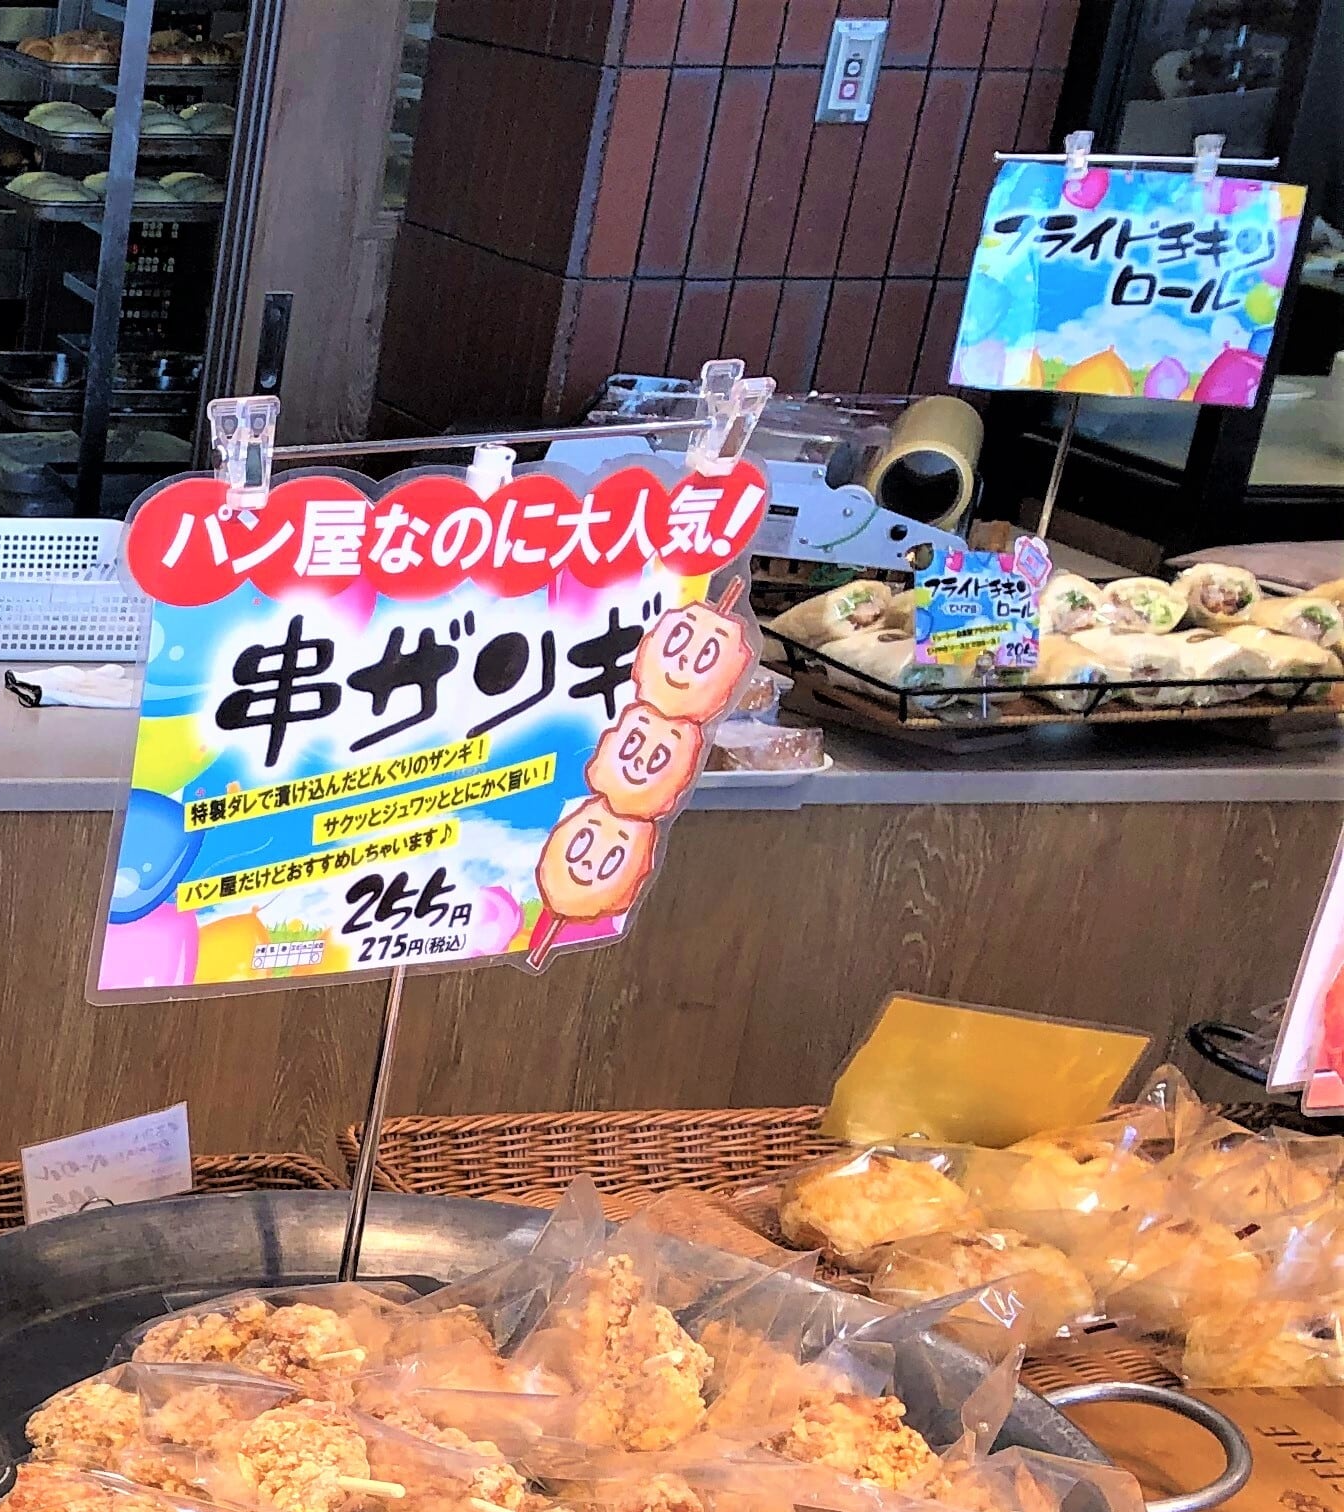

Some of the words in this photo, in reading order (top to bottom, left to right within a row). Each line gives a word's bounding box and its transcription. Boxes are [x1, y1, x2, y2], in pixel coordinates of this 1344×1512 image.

[993, 212, 1276, 267] フライドチキン
[1110, 265, 1242, 315] ロール
[924, 577, 1032, 601] フライドチキン
[997, 600, 1035, 619] ロール
[214, 592, 664, 767] 串ザンギ
[340, 866, 473, 935] 255円
[357, 933, 468, 962] 275円(税込)
